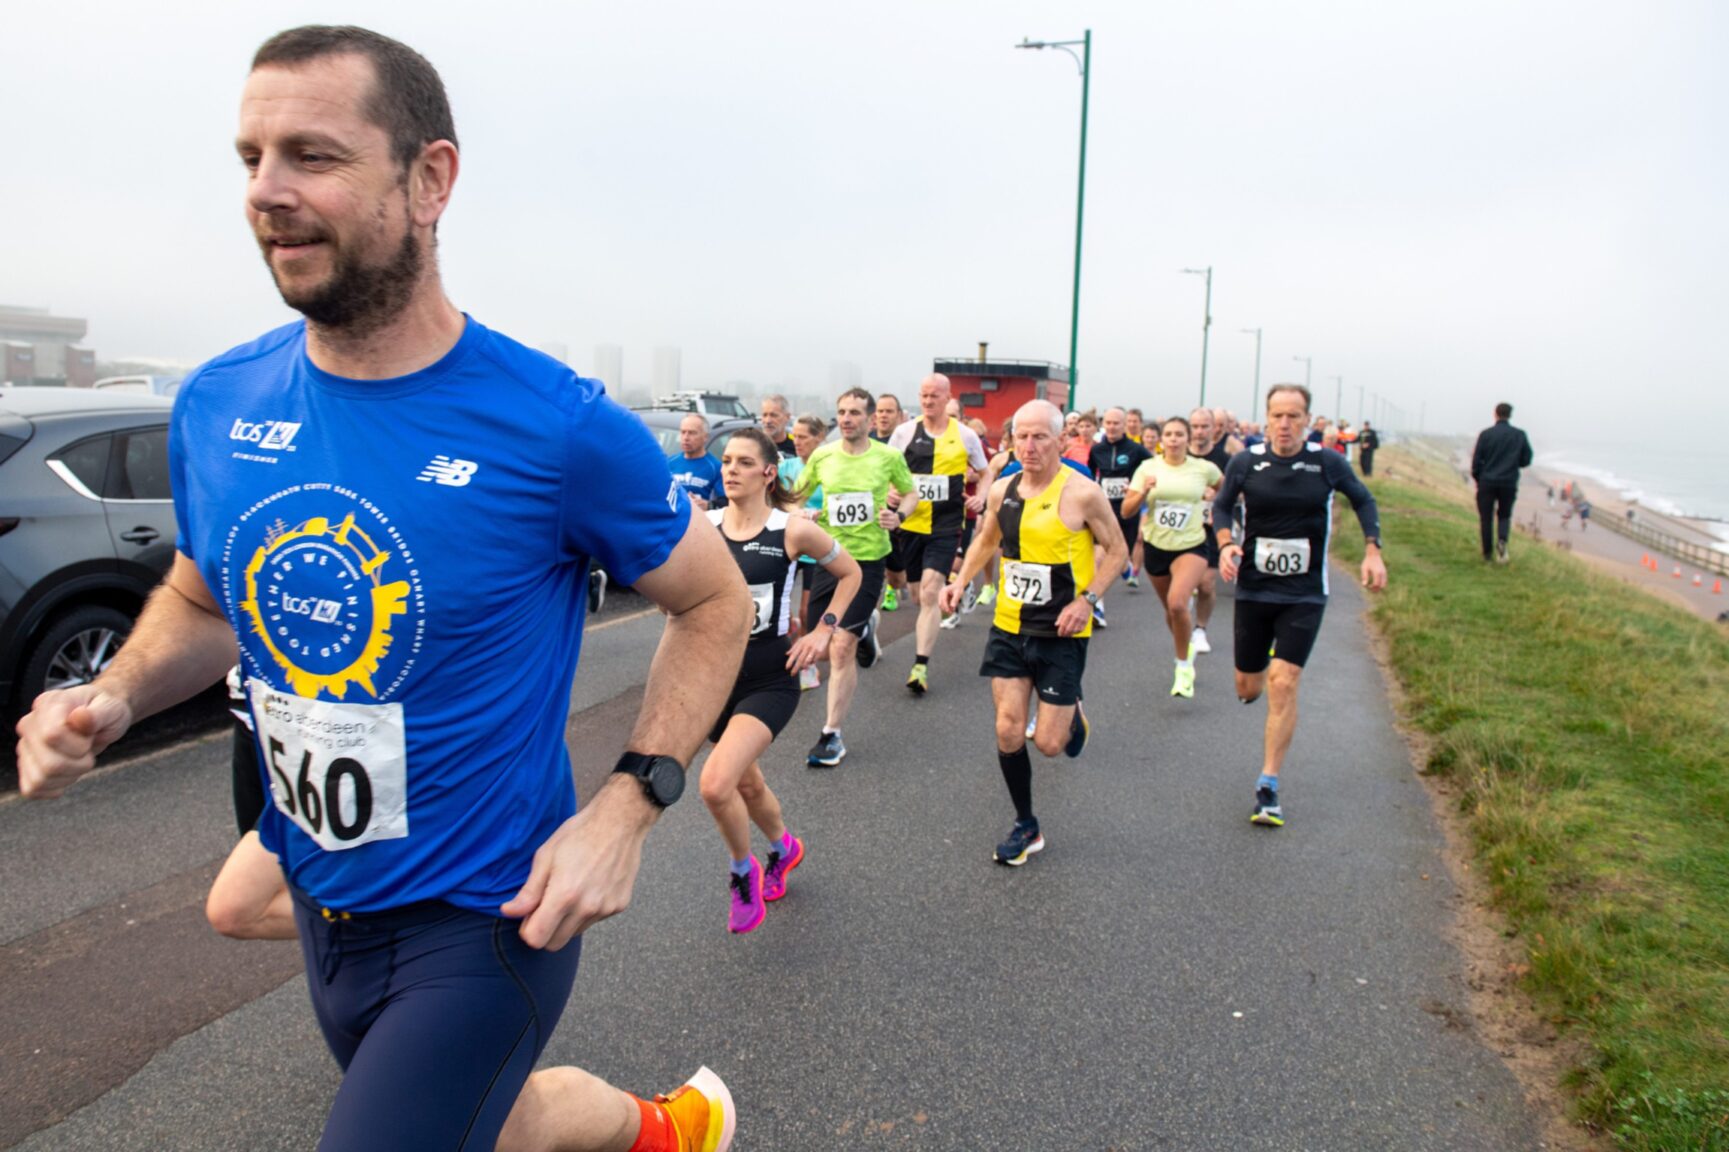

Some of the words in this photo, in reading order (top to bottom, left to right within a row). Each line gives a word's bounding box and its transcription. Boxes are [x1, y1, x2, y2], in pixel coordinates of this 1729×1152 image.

[919, 484, 941, 500] 561
[837, 503, 868, 524] 693
[1159, 510, 1187, 529] 687
[303, 553, 328, 566] WE
[1264, 552, 1302, 573] 603
[1010, 575, 1042, 602] 572
[269, 735, 373, 841] 560
